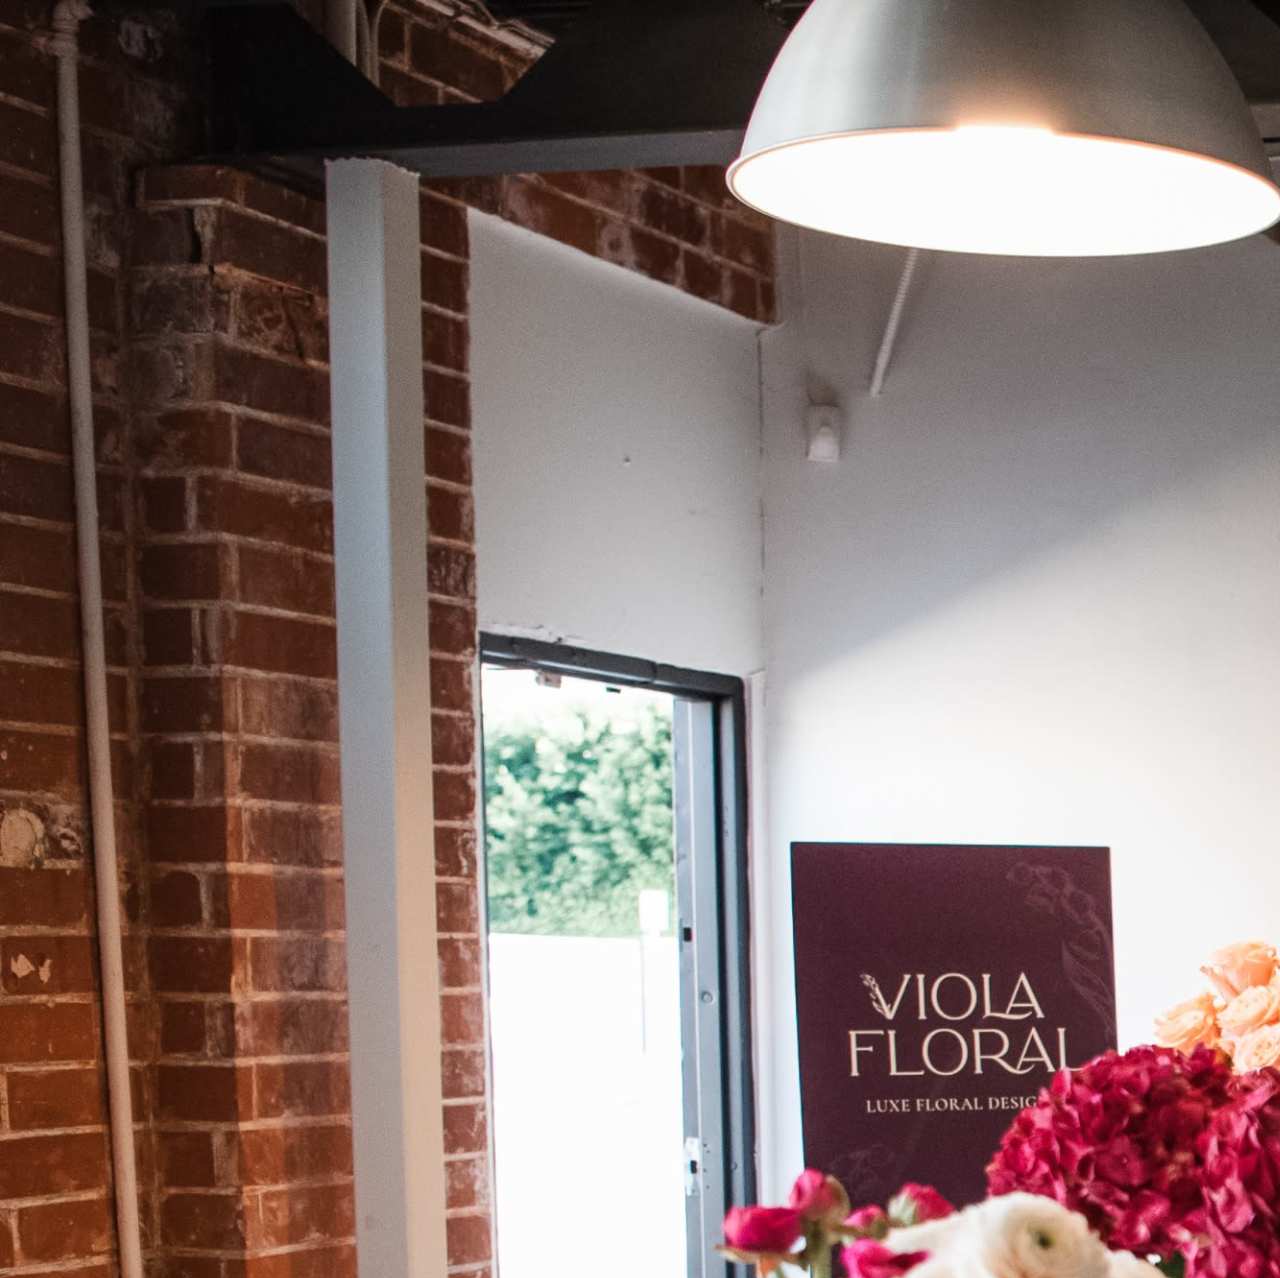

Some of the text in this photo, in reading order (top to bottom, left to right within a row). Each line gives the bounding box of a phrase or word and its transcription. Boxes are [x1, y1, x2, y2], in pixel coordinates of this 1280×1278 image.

[860, 973, 1045, 1020] VIOLA
[849, 1027, 1084, 1077] FLORAL
[866, 1096, 1038, 1113] LUXE FLORAL DESIG
